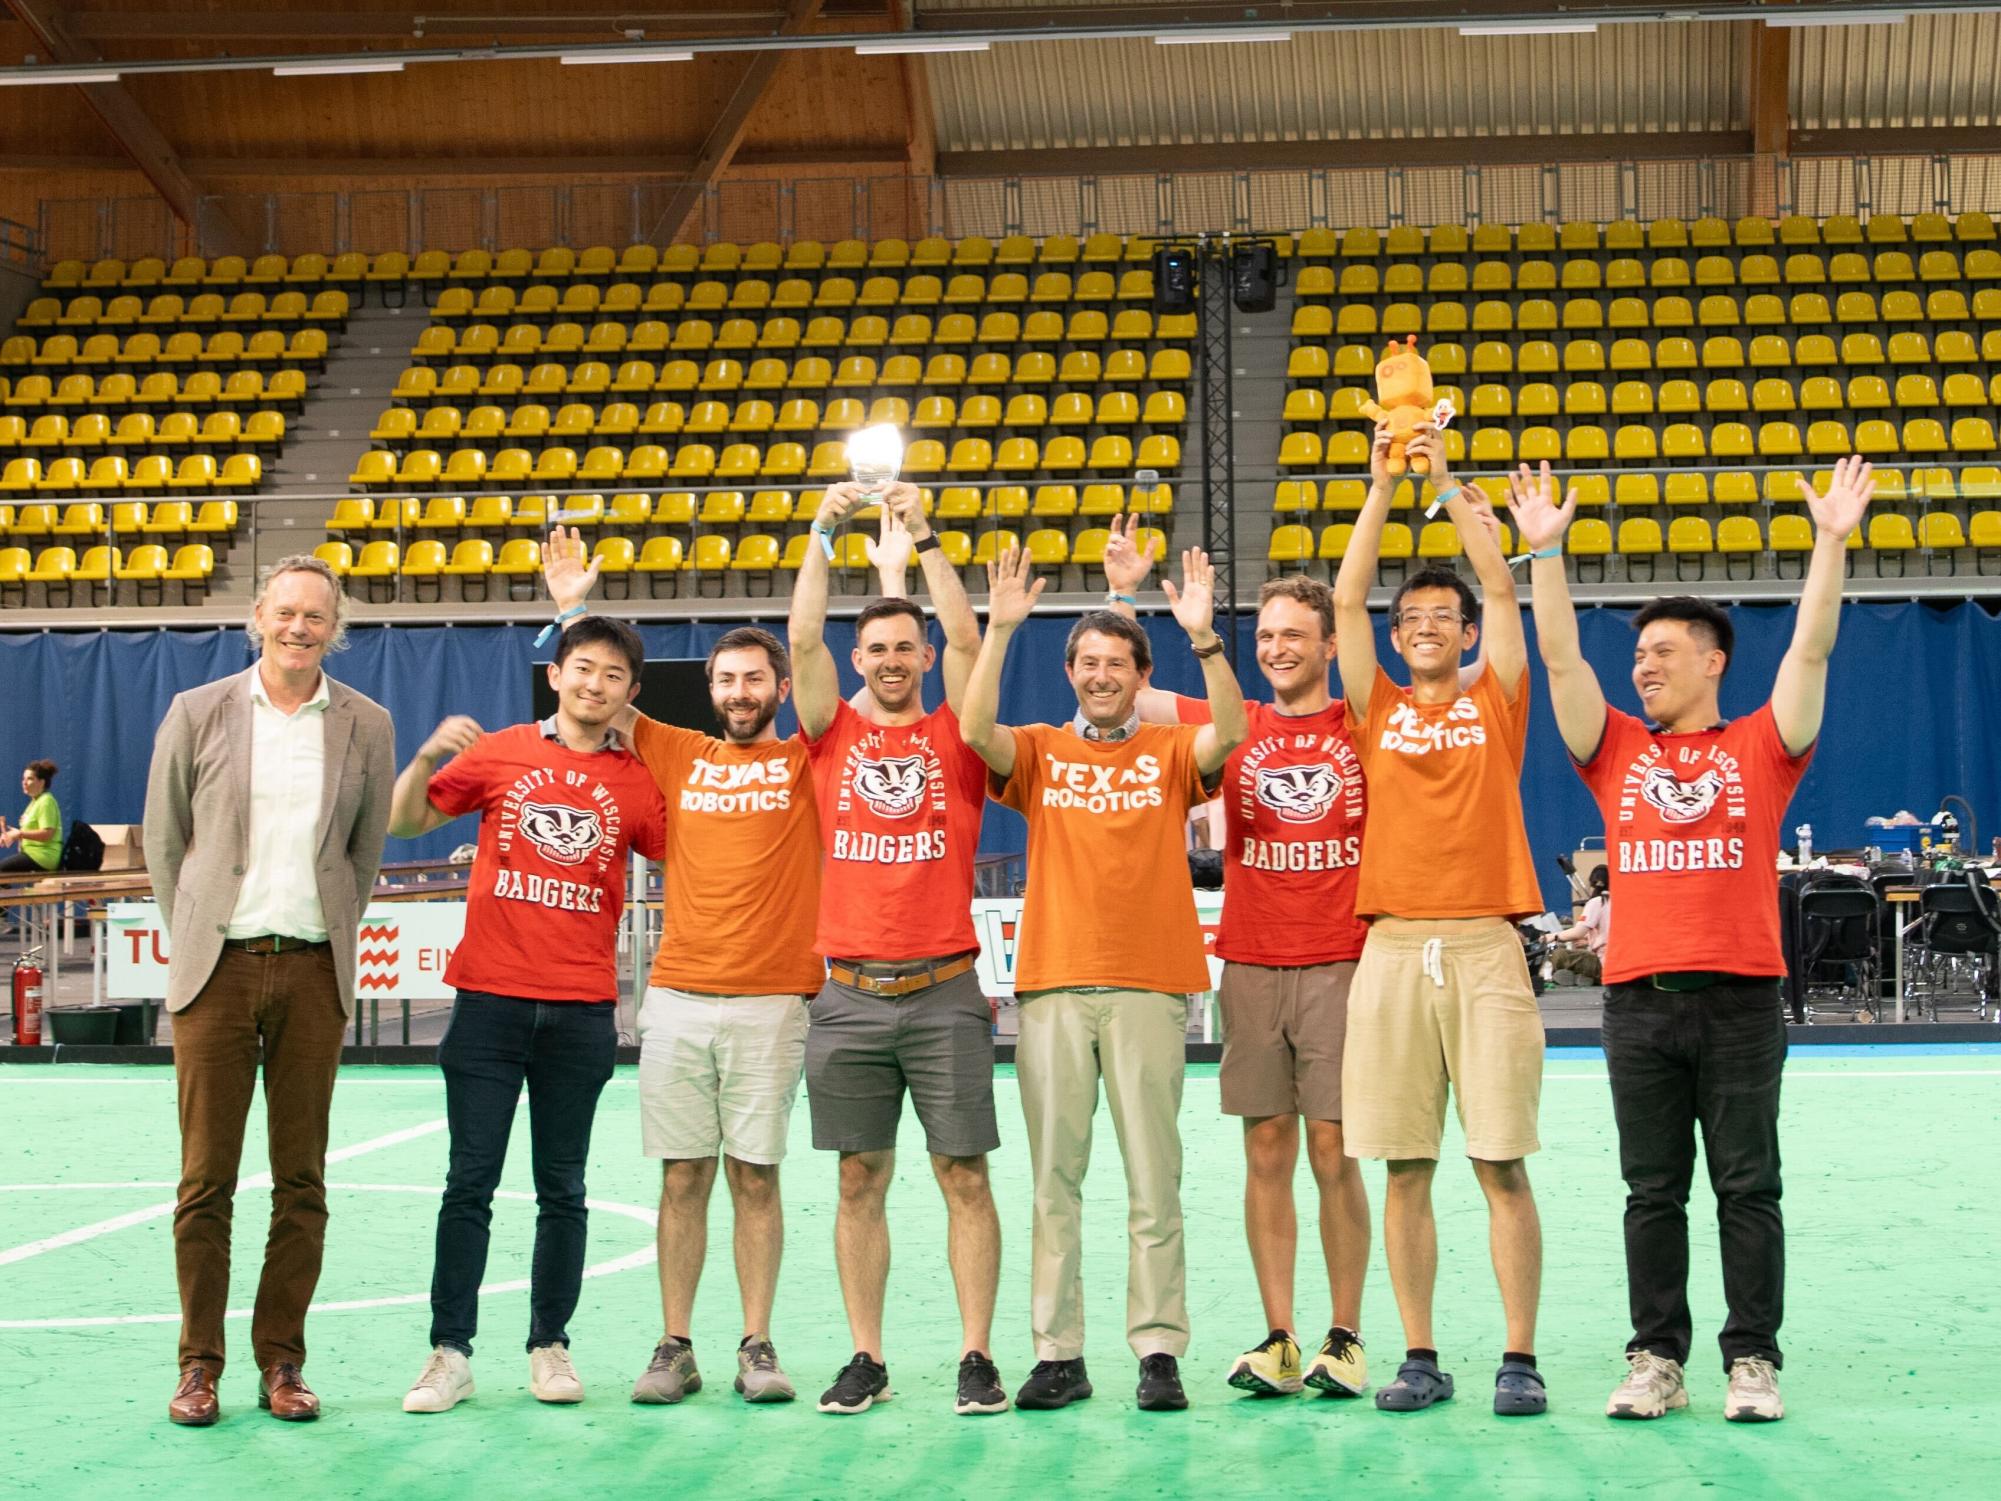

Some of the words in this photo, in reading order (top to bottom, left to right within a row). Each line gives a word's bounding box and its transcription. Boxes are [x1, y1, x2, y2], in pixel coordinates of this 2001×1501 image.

[1388, 696, 1479, 739] TEXS
[688, 758, 791, 790] TEXAS
[910, 733, 946, 810] WISONSIN
[1046, 753, 1161, 794] TEXAS
[1239, 736, 1286, 819] UNIVERSITY
[1295, 734, 1317, 748] OF
[1619, 743, 1668, 821] UNIVERS
[1679, 747, 1702, 765] OF
[498, 767, 555, 852] UNIVERSITY
[565, 770, 588, 787] OF
[591, 783, 621, 872] WISCONSIN
[680, 789, 791, 813] ROBOTICS
[1042, 787, 1162, 814] ROBOTICS
[833, 829, 946, 863] BADGERS
[1241, 837, 1360, 871] BADGERS
[1619, 838, 1743, 873] BADGERS
[493, 869, 605, 913] BADGERS
